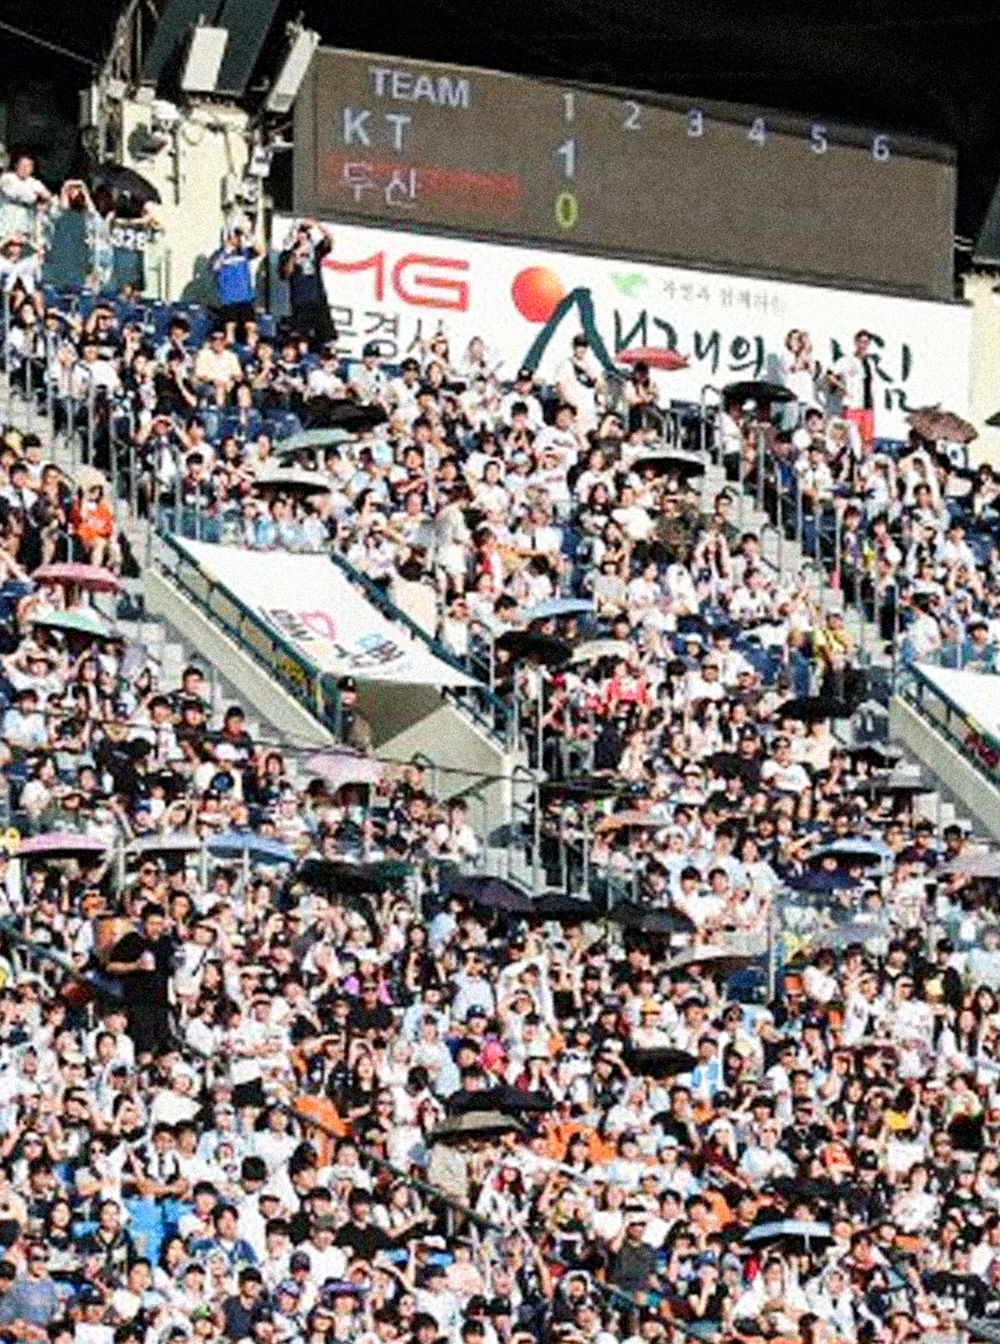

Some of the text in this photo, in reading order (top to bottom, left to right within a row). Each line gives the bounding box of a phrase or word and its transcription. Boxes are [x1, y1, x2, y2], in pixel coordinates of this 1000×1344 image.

[369, 66, 471, 108] TEAM
[564, 93, 889, 162] 1 2 3 4 5 6
[558, 139, 576, 178] 1
[342, 161, 579, 229] 두산 0
